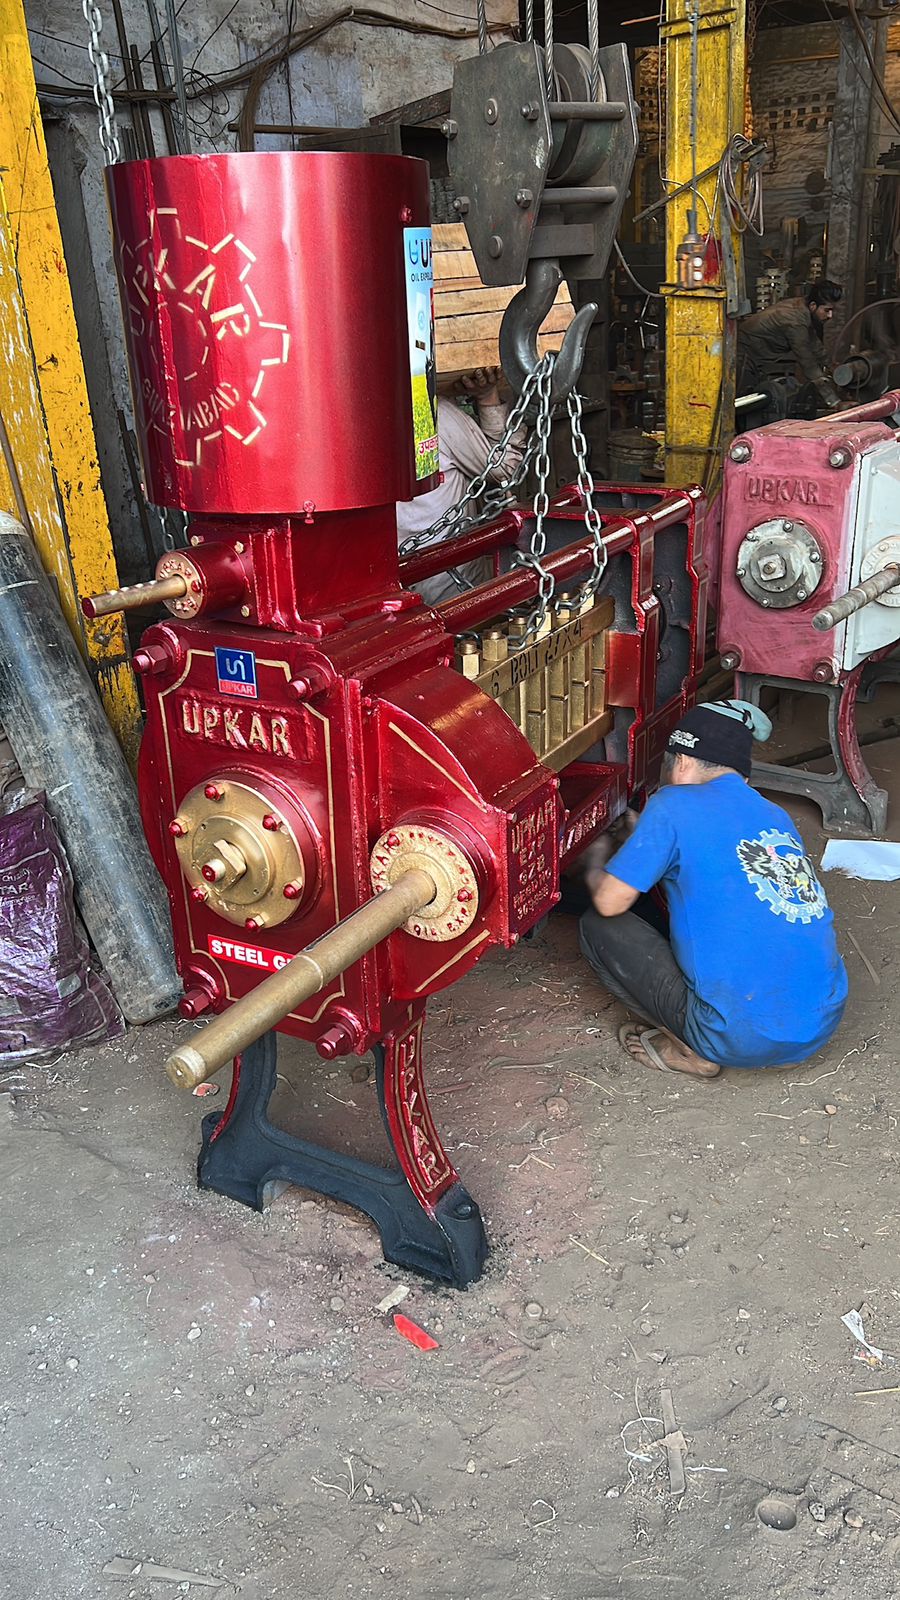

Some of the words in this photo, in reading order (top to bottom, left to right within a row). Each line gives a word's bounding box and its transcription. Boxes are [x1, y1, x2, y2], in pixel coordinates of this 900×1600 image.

[747, 478, 818, 504] UPKAR
[511, 645, 539, 686] BOLT
[221, 681, 254, 695] UPKAR
[182, 699, 296, 759] UPKAR
[211, 939, 269, 967] STEEL
[273, 955, 293, 970] G
[400, 1034, 442, 1189] UPKAR
